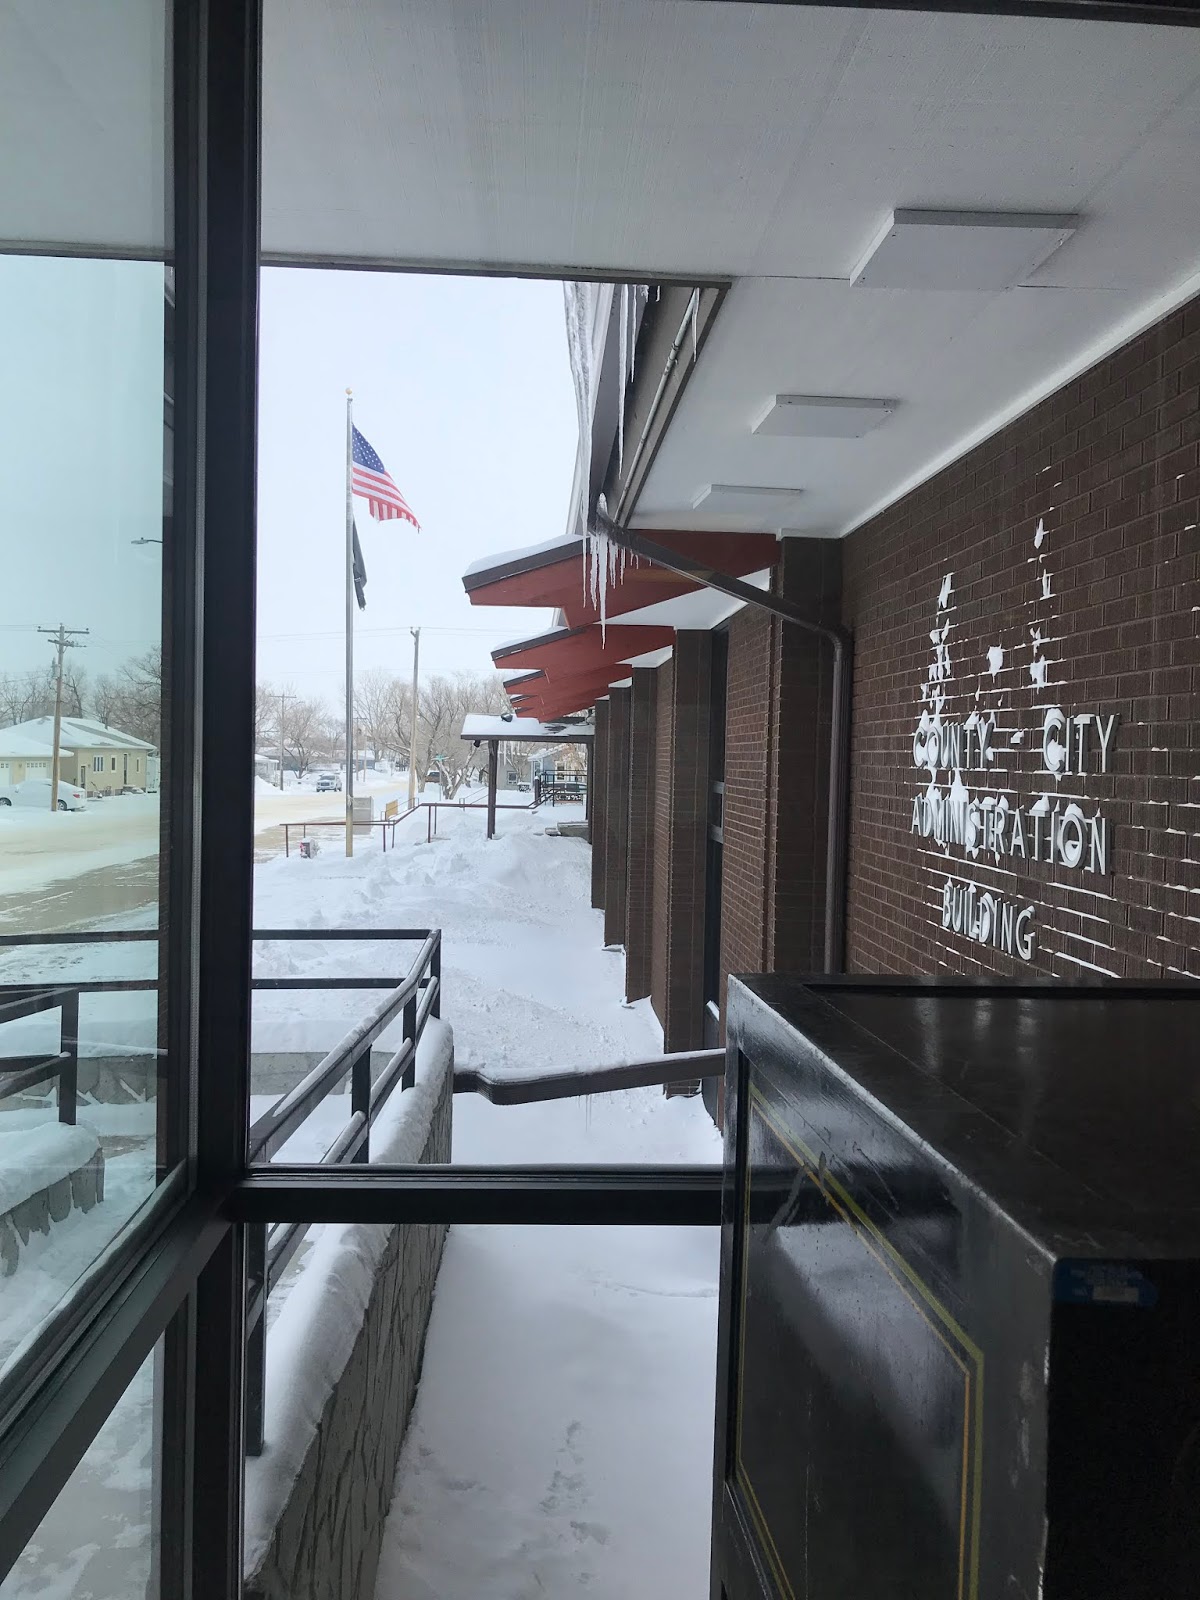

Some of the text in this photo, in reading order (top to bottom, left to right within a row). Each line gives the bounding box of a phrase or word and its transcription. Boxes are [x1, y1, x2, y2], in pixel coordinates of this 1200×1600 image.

[912, 719, 993, 769] COUNTY
[1043, 713, 1118, 773] CITY
[911, 794, 1109, 875] ADMINISTRATION
[942, 882, 1036, 961] BUILDING
